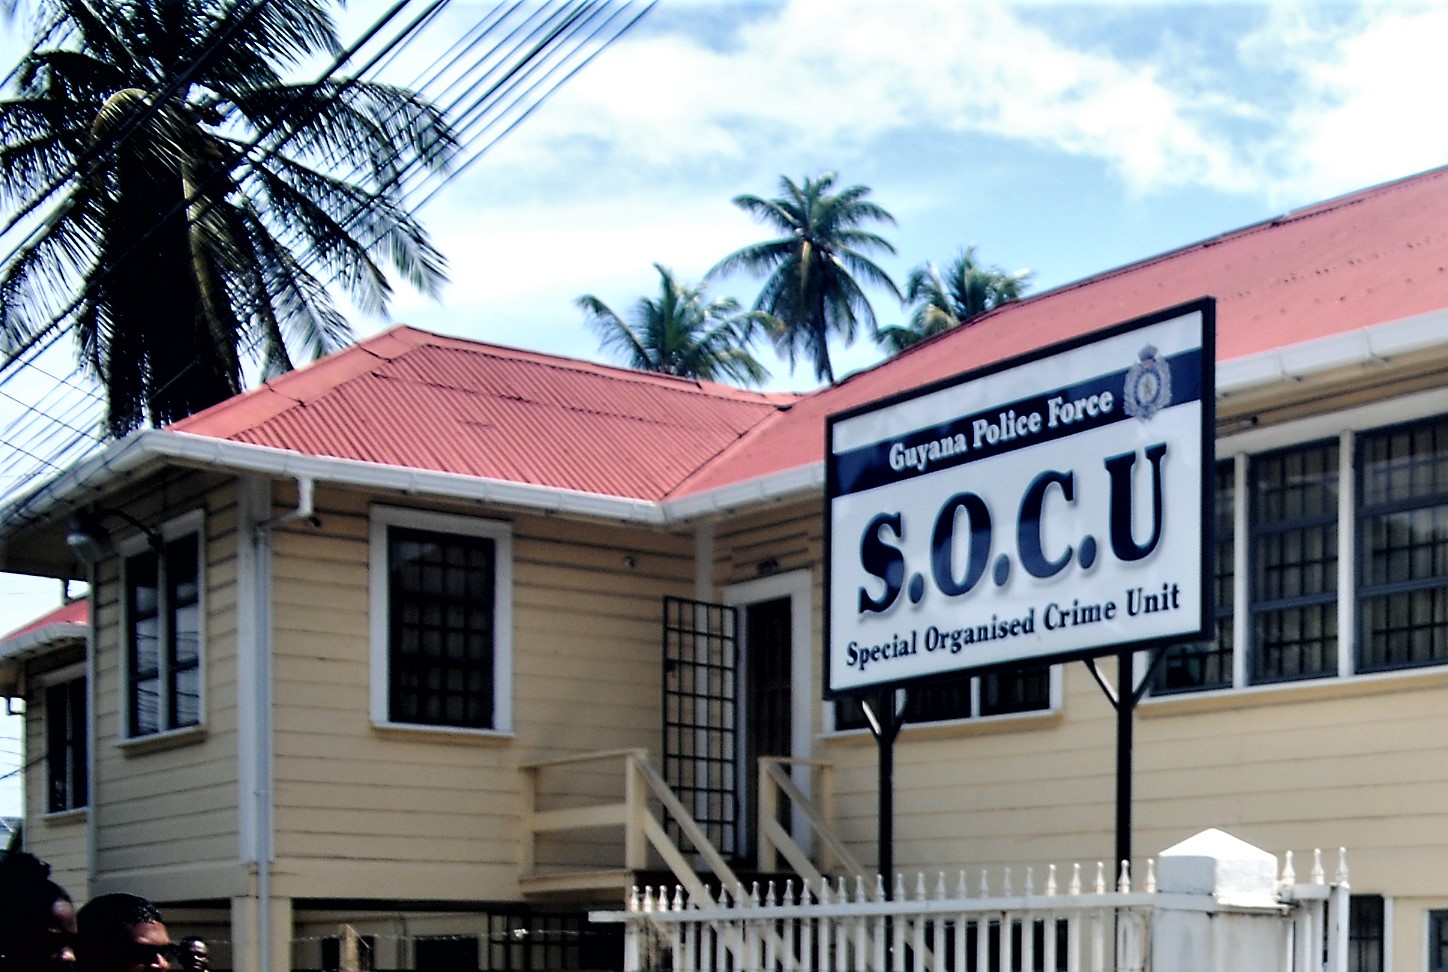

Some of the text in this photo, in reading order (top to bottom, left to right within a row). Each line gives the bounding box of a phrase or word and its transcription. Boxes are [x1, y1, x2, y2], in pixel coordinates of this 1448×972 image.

[889, 391, 1114, 472] Guyana Police Force
[858, 442, 1167, 614] S.O.C.U
[846, 582, 1180, 671] Special Organised Crime Unit
